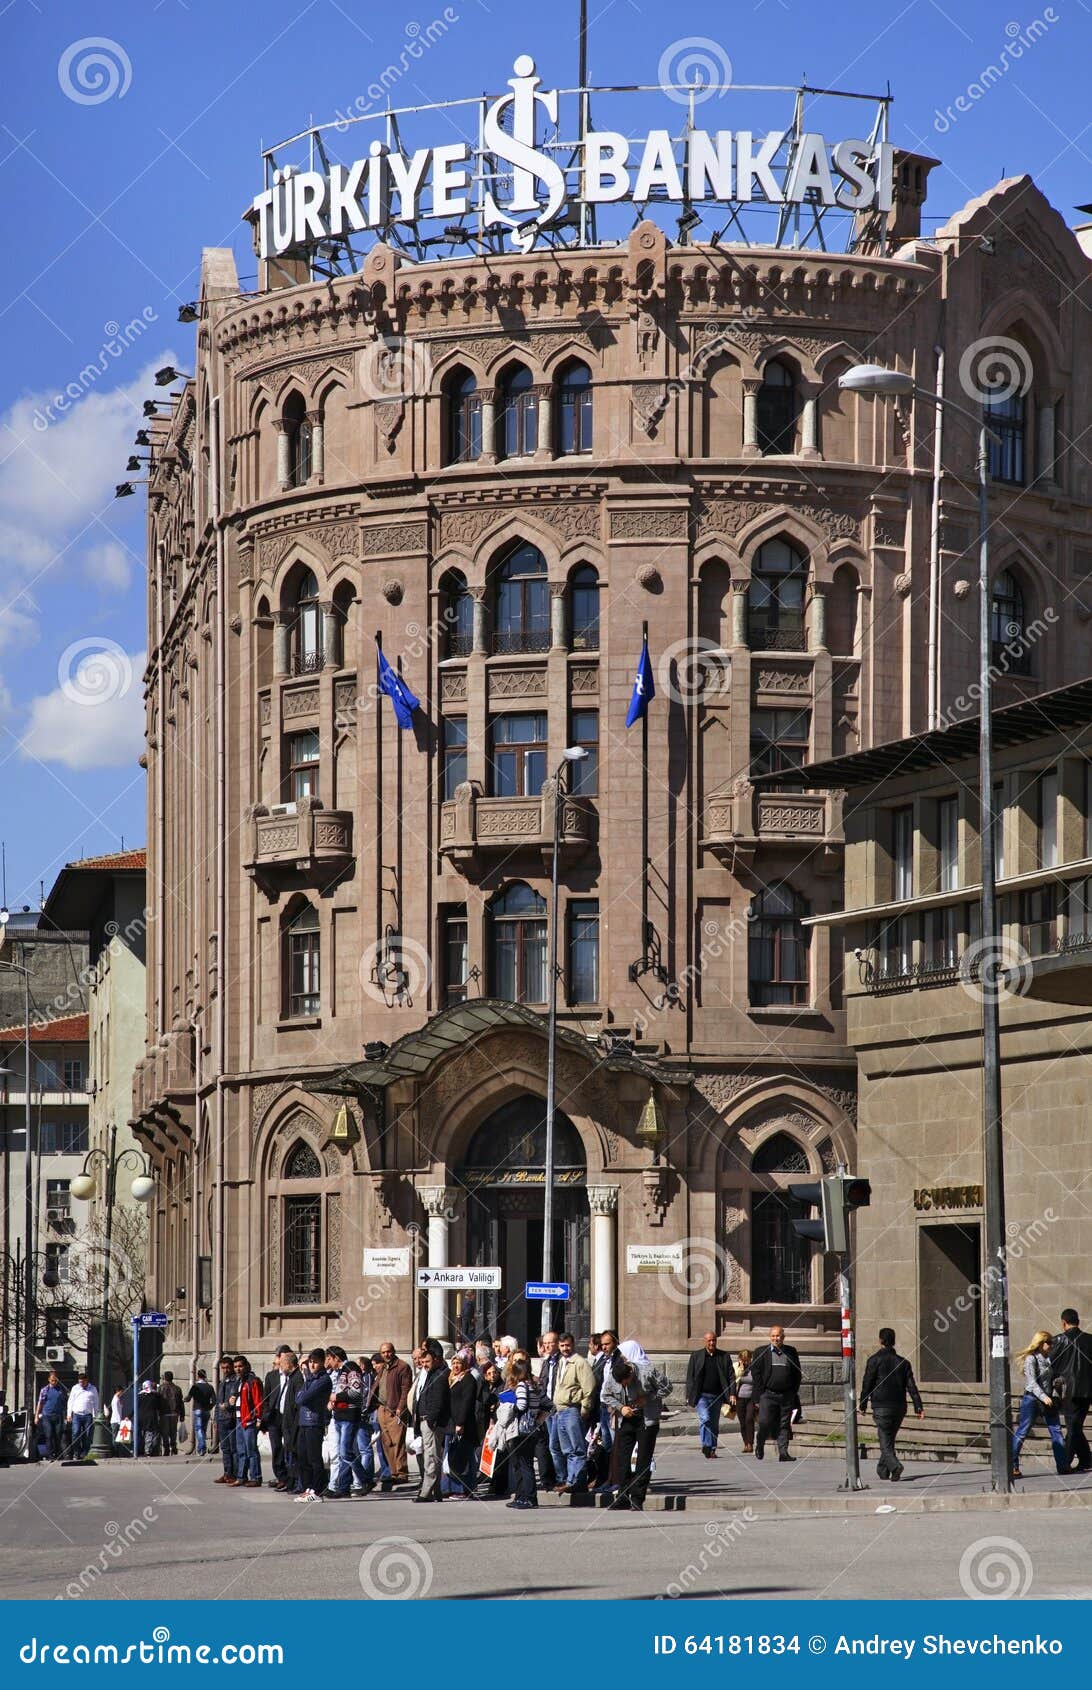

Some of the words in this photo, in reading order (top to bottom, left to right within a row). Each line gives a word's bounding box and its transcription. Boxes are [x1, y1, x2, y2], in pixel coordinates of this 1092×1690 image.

[253, 141, 471, 259] TÜRKİYE
[585, 130, 894, 213] BANKASI
[433, 1272, 464, 1282] Ankara
